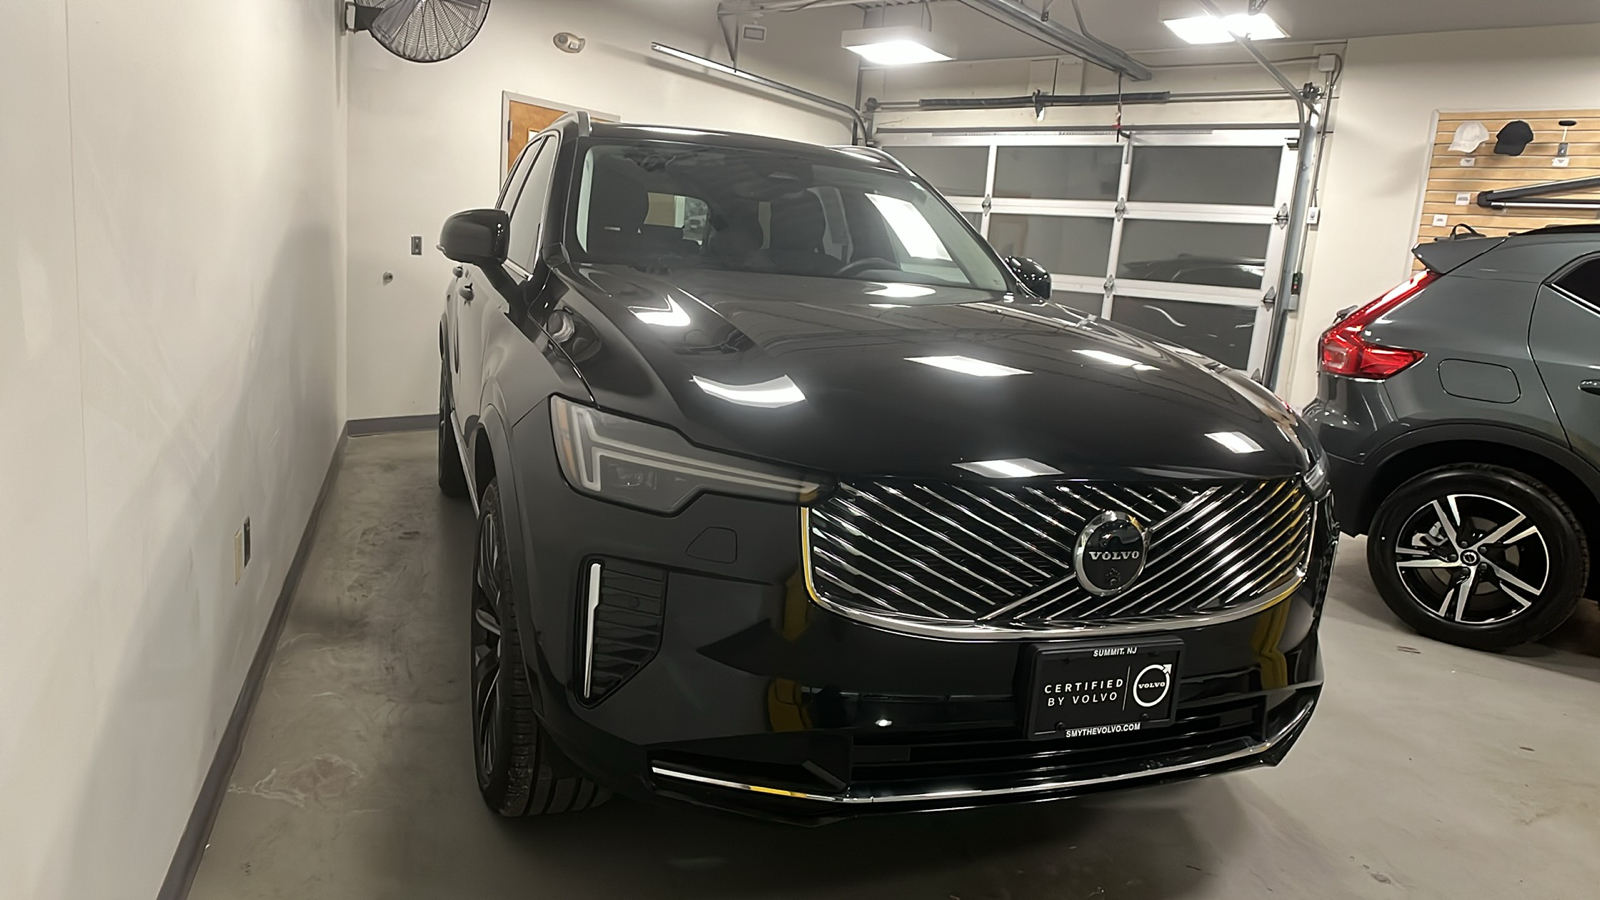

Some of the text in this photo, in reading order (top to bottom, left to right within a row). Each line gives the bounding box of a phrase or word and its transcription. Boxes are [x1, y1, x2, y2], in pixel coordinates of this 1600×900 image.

[1088, 550, 1140, 561] VOLVO
[1126, 647, 1138, 655] NJ
[1044, 679, 1123, 693] CERTIFIED
[1047, 692, 1117, 707] BY VOLVO
[1065, 722, 1141, 738] SMYTHEVOLVO.COM
